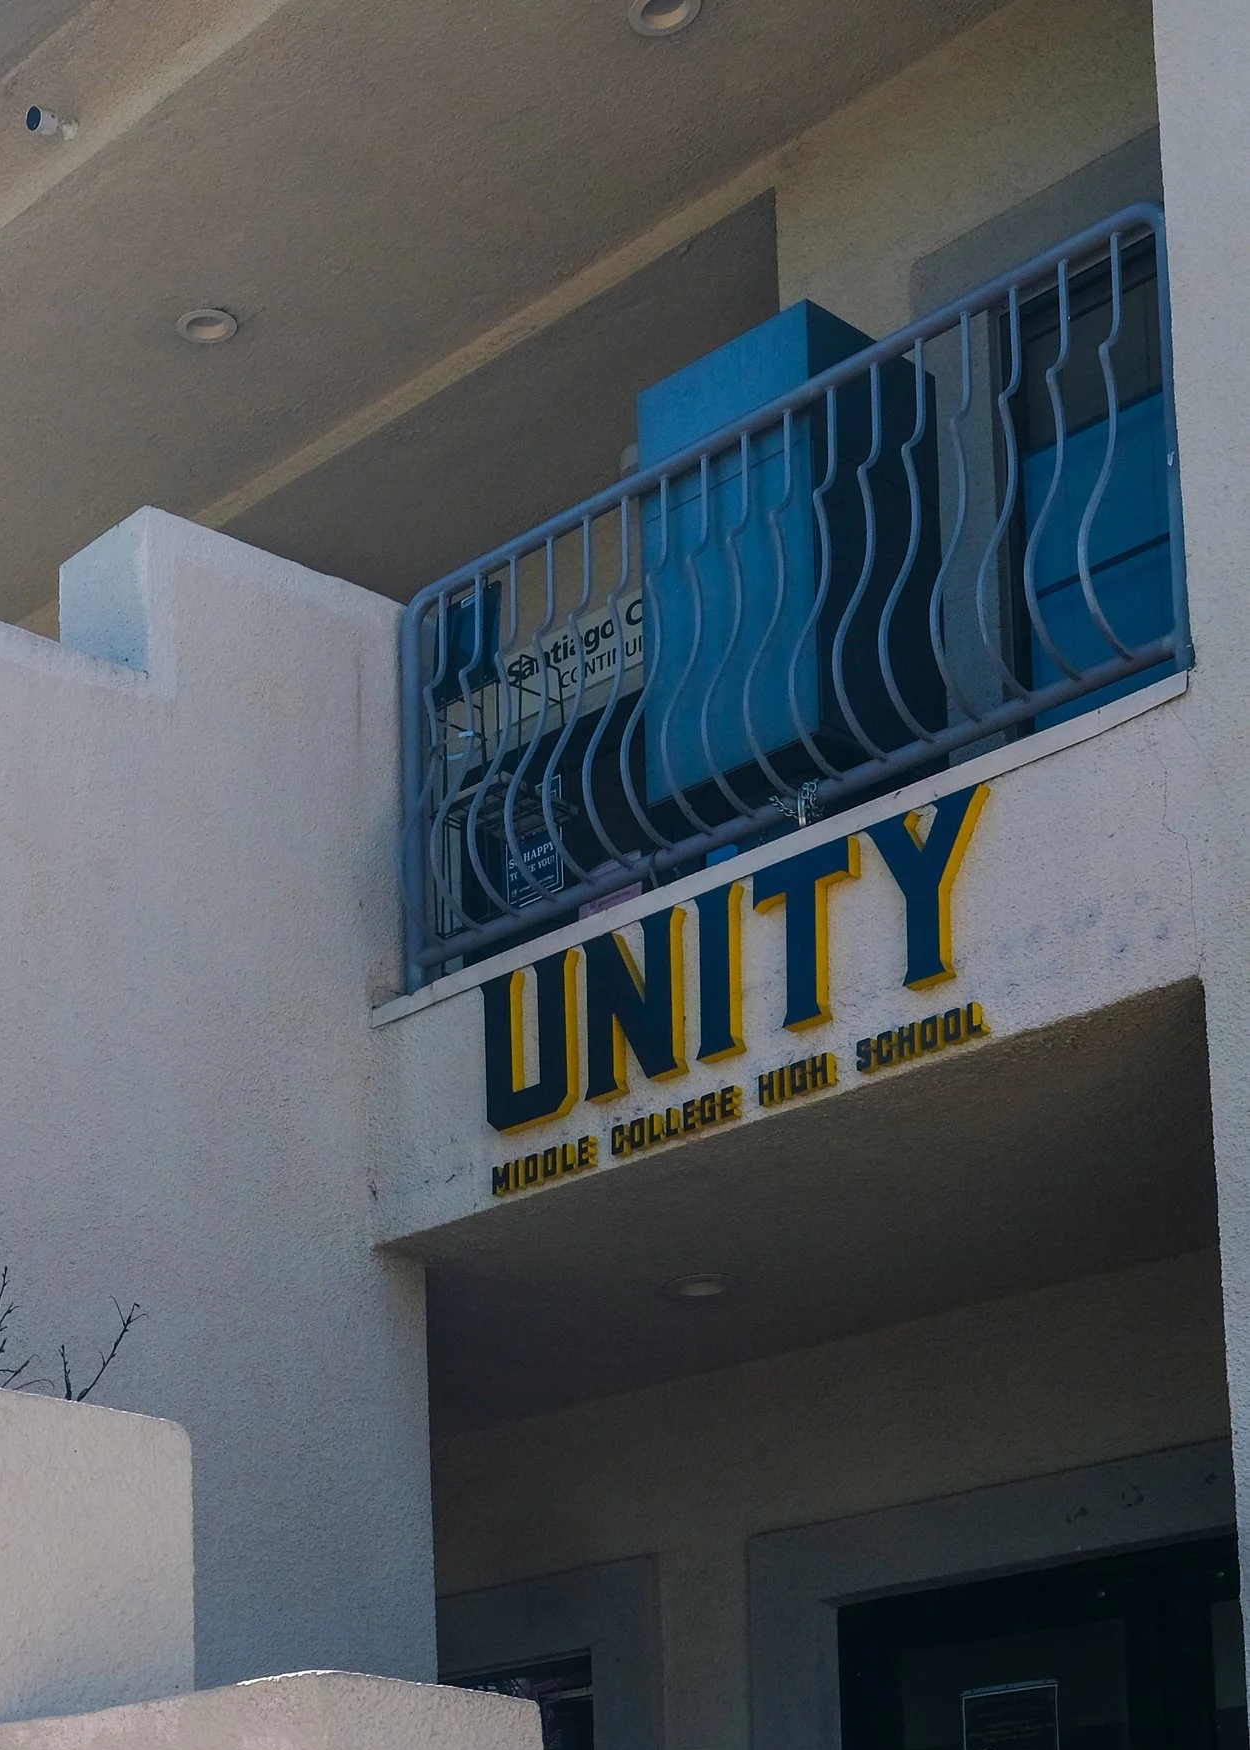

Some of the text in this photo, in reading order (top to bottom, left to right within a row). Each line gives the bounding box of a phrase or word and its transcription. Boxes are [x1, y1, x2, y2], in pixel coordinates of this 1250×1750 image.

[523, 841, 554, 863] HAPPY
[479, 783, 990, 1135] UNITY
[492, 1001, 990, 1197] MIDDLE COLLEGE HIGH SCHOOL
